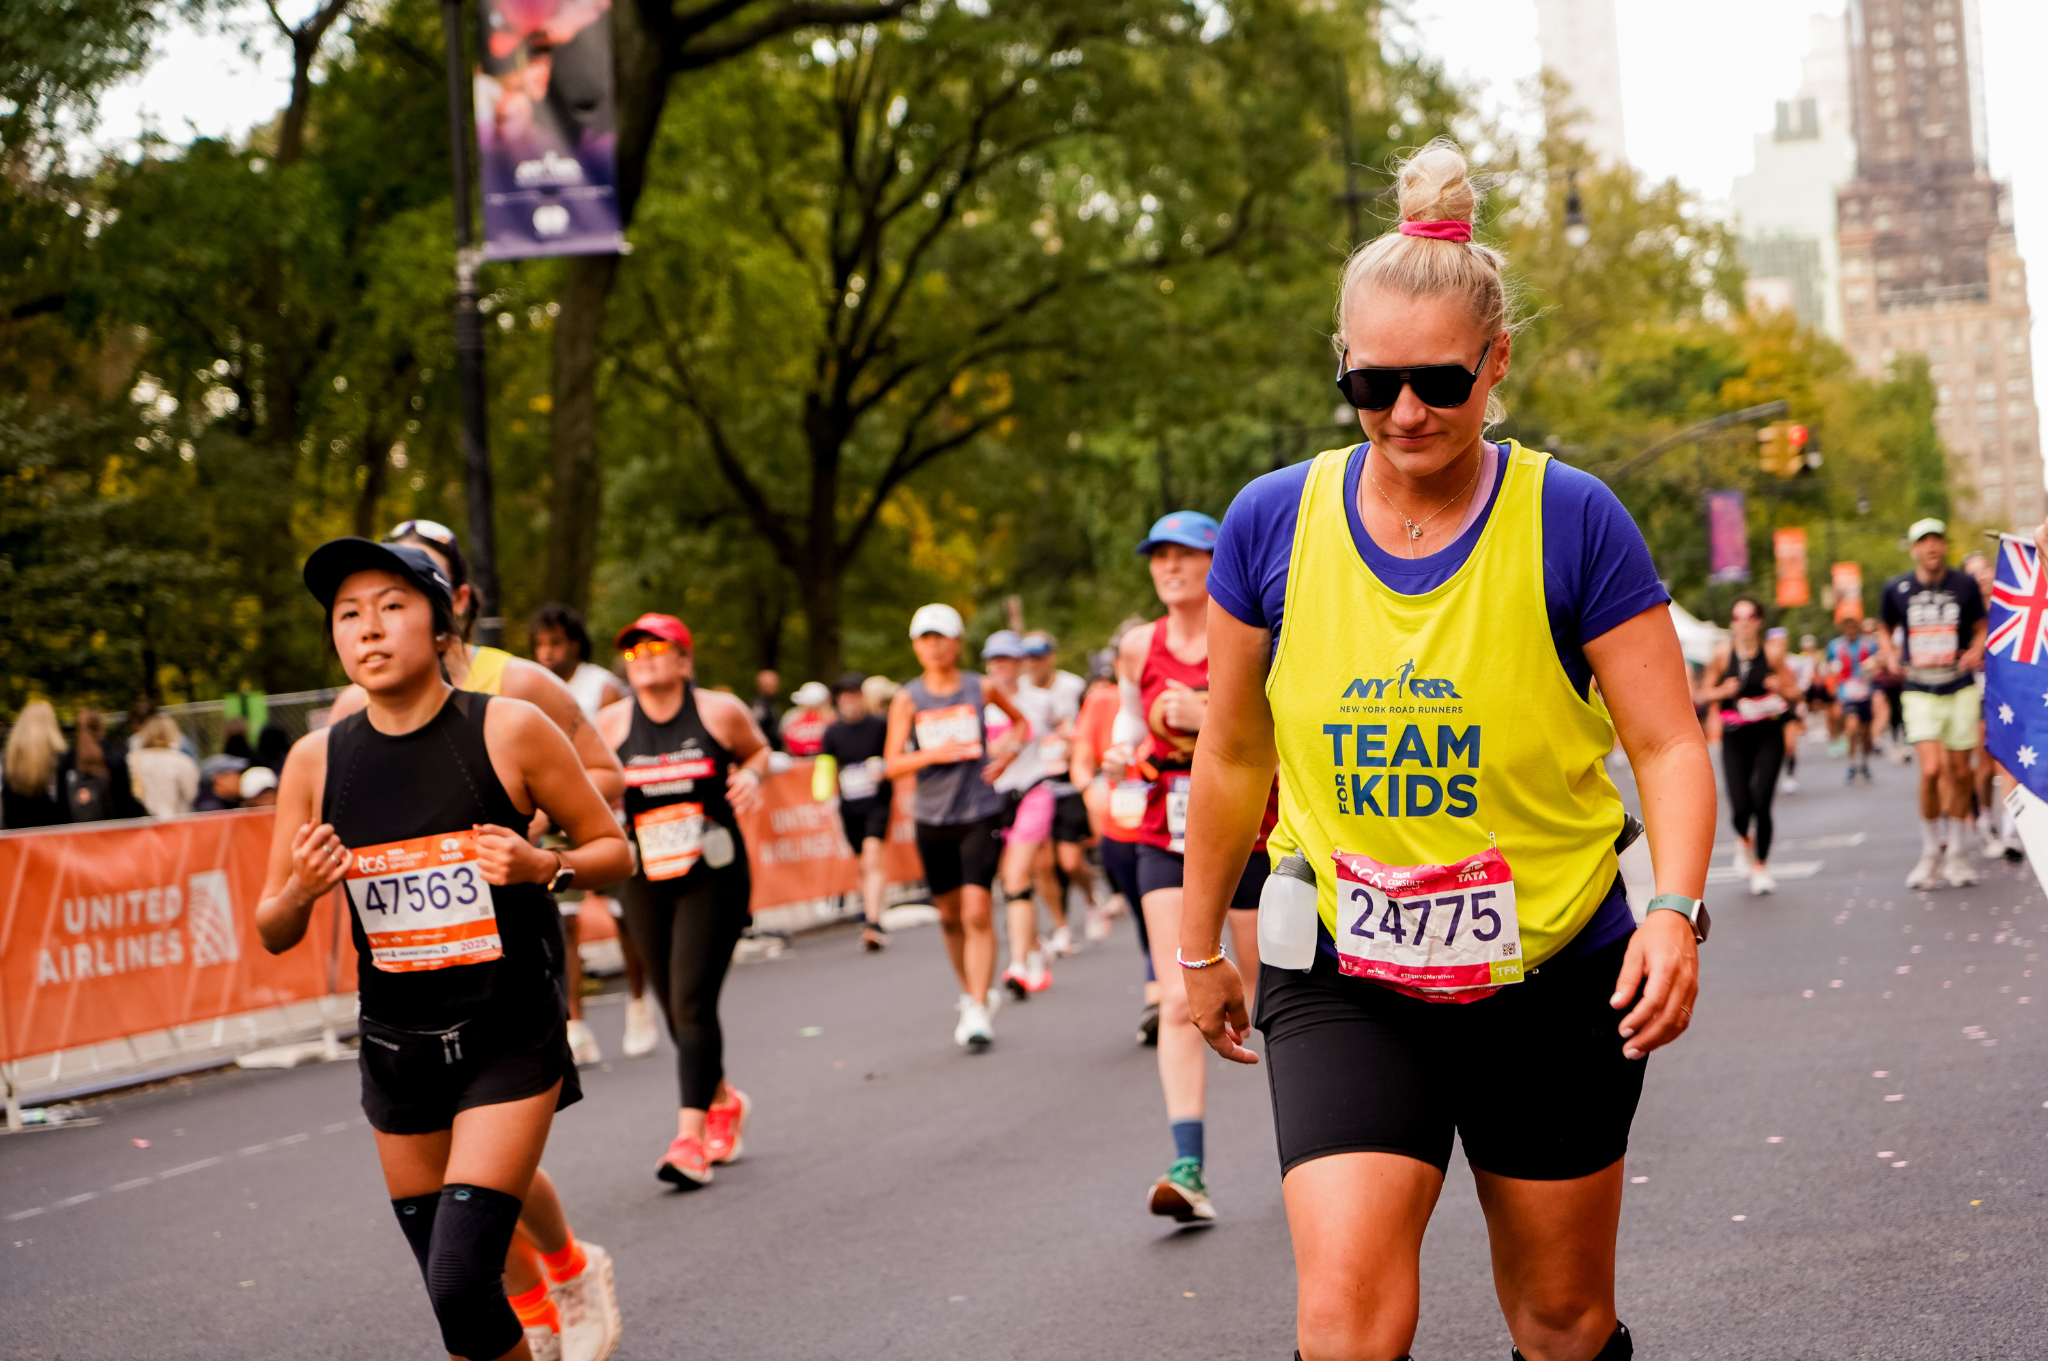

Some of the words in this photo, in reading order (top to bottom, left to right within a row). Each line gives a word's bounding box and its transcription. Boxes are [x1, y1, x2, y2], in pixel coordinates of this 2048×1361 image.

[1340, 705, 1360, 713] NEW
[1362, 706, 1386, 714] YORK
[1389, 706, 1415, 714] ROAD
[1418, 706, 1463, 714] RUNNERS
[1323, 723, 1481, 769] TEAM
[1335, 773, 1350, 815] FOR
[1351, 774, 1478, 818] KIDS
[386, 848, 405, 856] TATA
[439, 851, 464, 862] TATA
[1392, 871, 1411, 879] TATA
[1456, 870, 1488, 883] TATA
[1387, 879, 1425, 888] CONSULT
[366, 867, 478, 915] 47563
[63, 884, 183, 935] UNITED
[1350, 888, 1502, 946] 24775
[441, 945, 449, 954] D
[461, 938, 488, 951] 2025
[37, 928, 184, 988] AIRLINES
[1496, 965, 1519, 977] TFK
